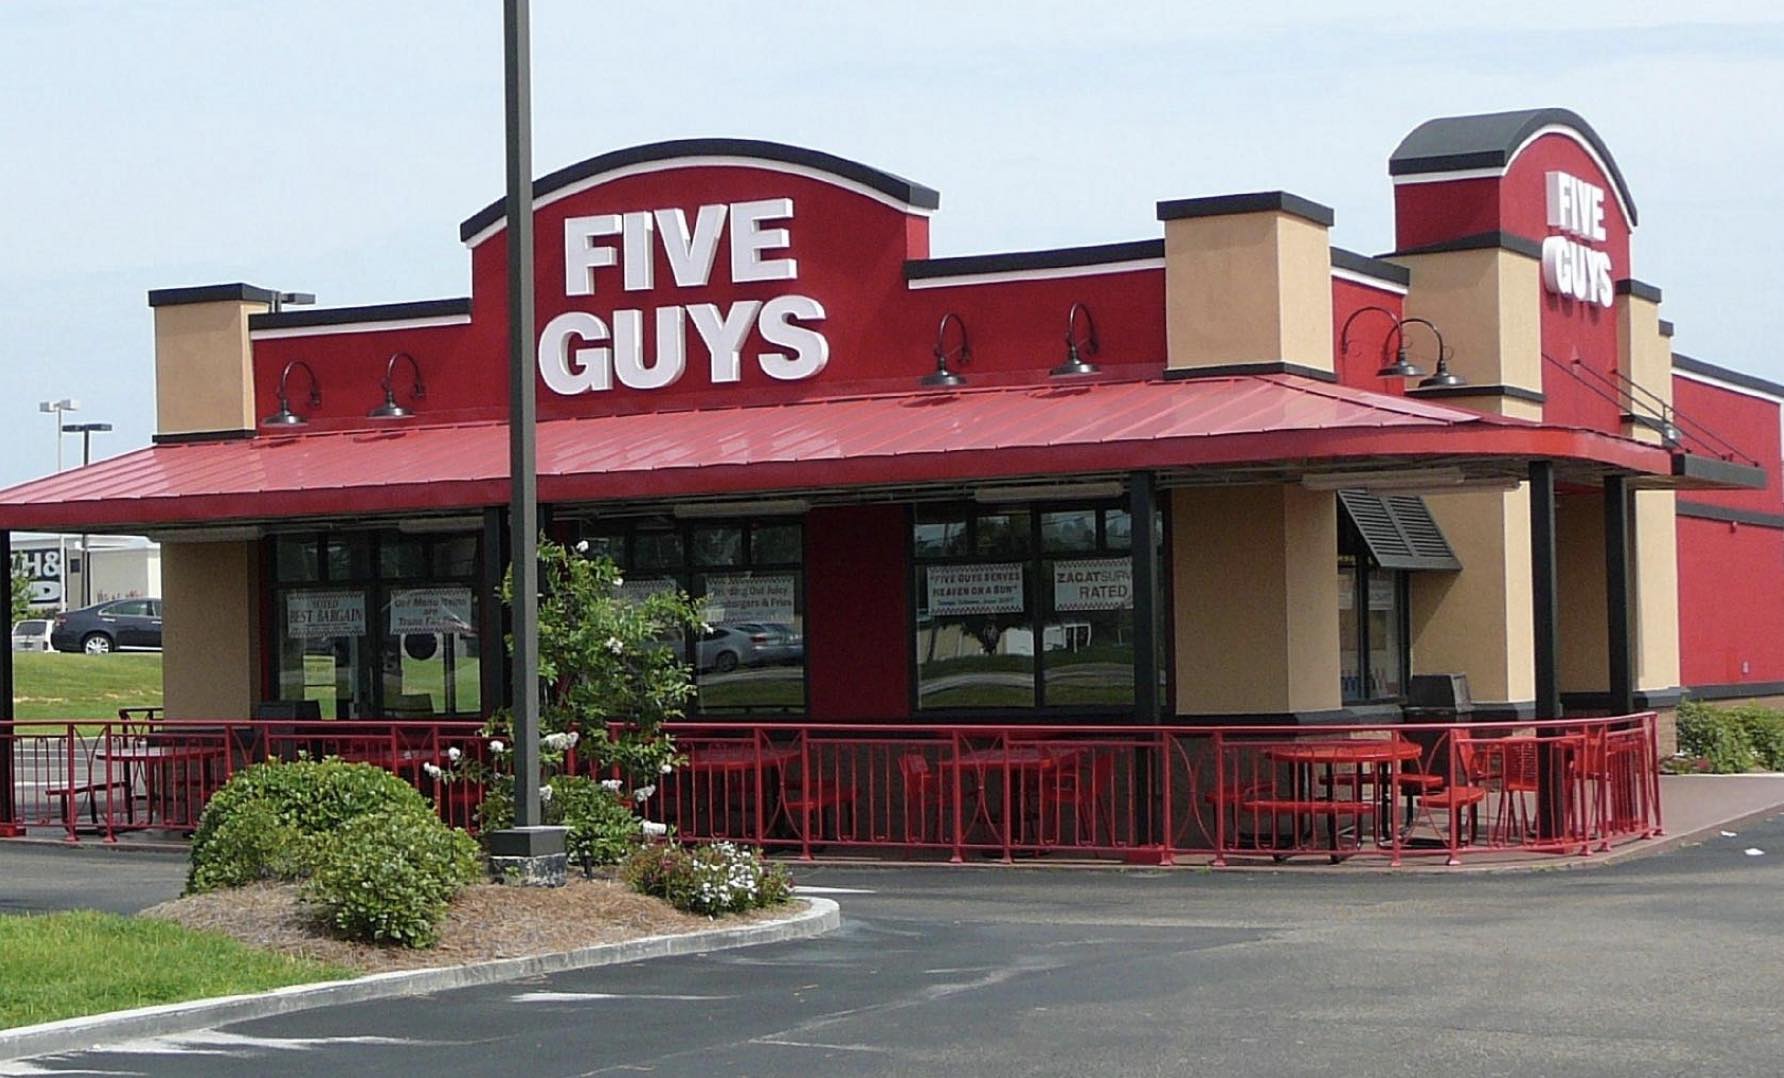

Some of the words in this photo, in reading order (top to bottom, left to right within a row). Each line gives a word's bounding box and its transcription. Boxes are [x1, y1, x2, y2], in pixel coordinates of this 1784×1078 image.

[1545, 171, 1606, 241] FIVE
[564, 198, 797, 296] FIVE
[1542, 236, 1613, 308] GUYS
[538, 295, 829, 395] GUYS
[289, 610, 313, 624] BEST
[317, 608, 363, 623] BARGAIN
[1079, 585, 1128, 600] RATED
